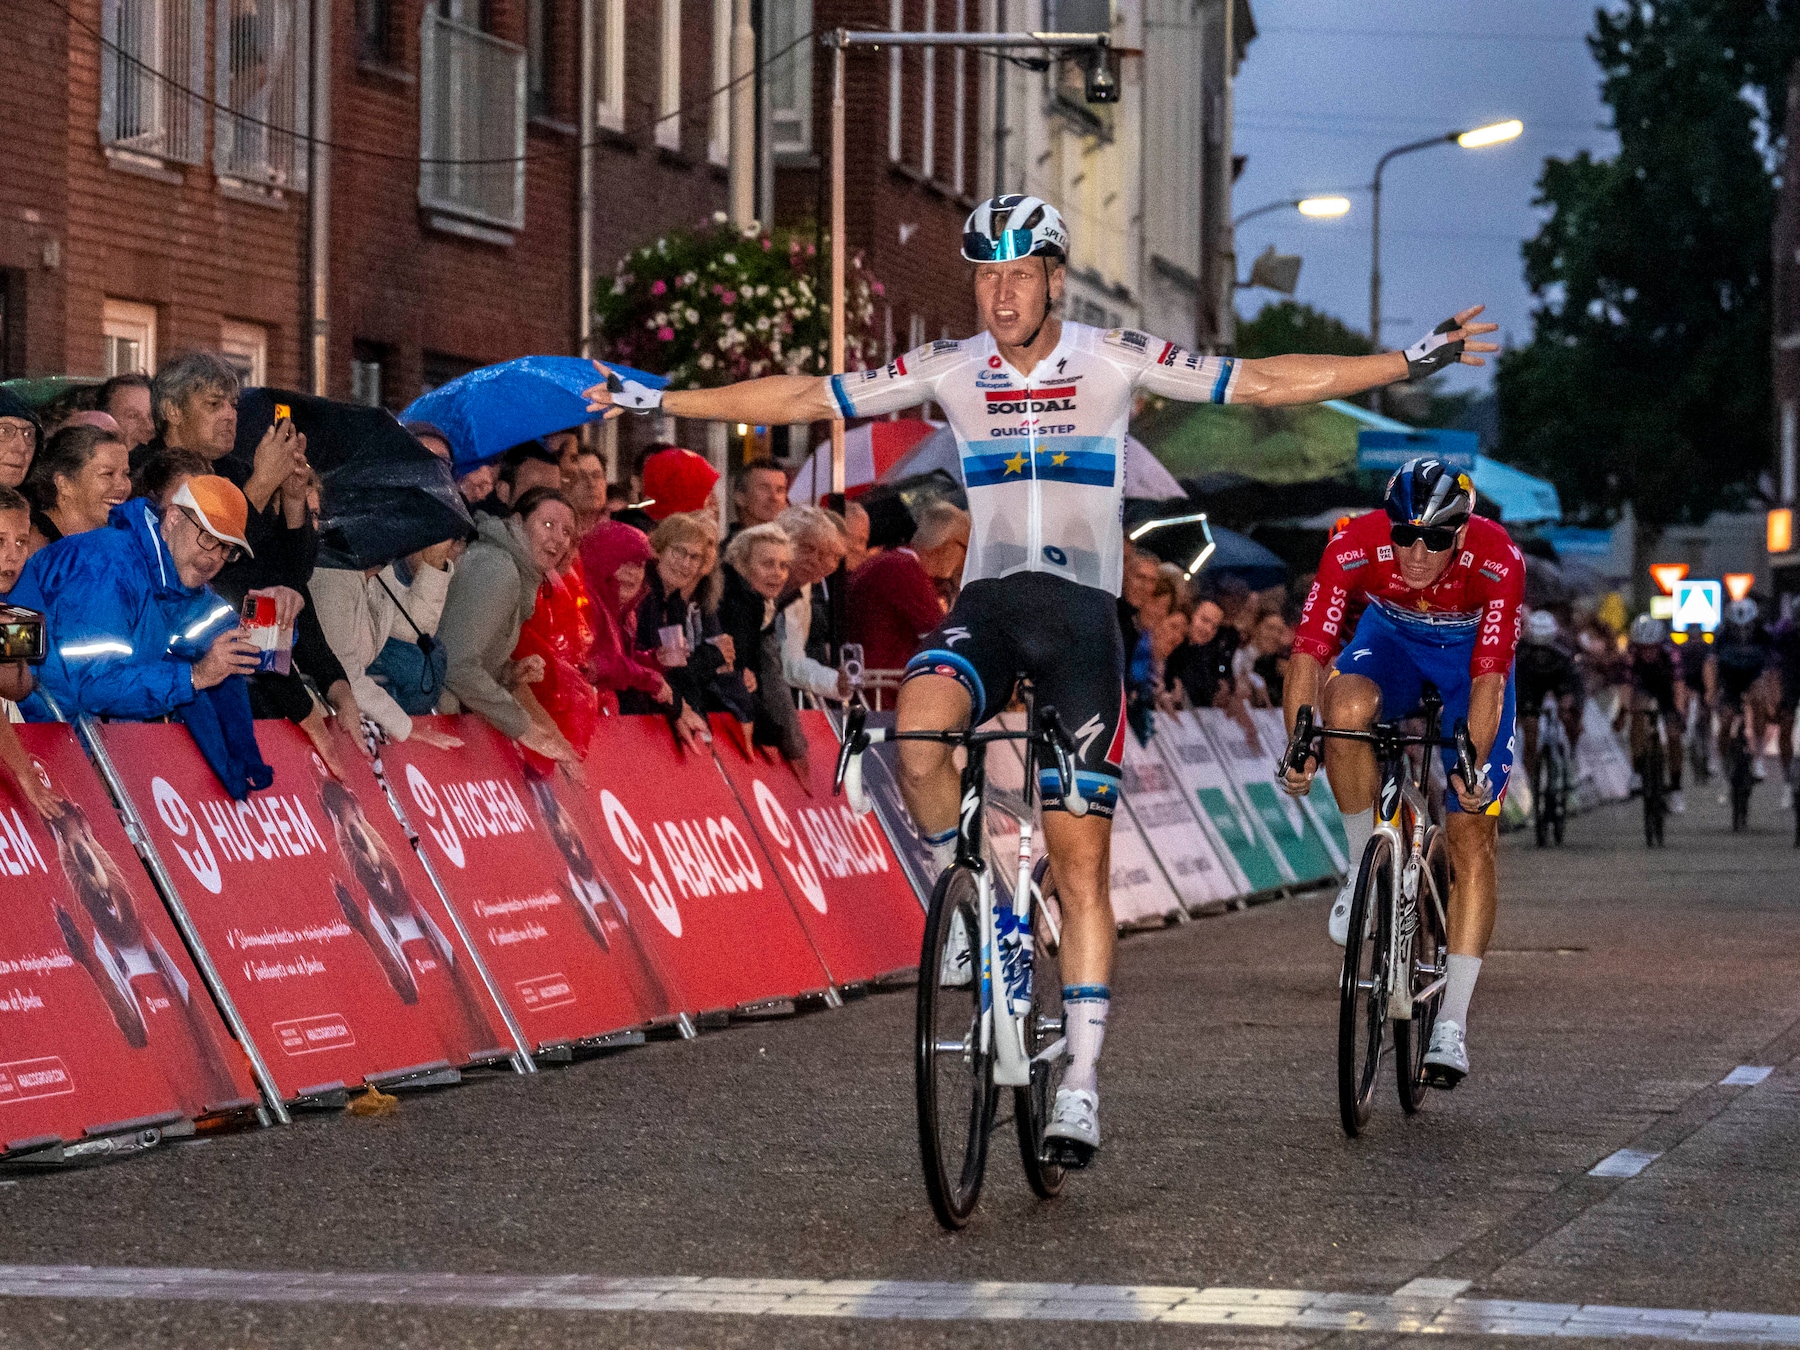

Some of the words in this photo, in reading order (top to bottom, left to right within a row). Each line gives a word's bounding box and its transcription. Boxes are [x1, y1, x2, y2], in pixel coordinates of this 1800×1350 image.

[975, 380, 1013, 389] Ekopak
[987, 399, 1076, 415] SOUDAL
[1336, 548, 1366, 564] BORA
[1322, 585, 1347, 636] BOSS
[1481, 599, 1504, 646] BOSS
[199, 794, 327, 862] HUCHEM
[441, 778, 535, 839] HUCHEM
[653, 815, 763, 900] ABALCO
[798, 805, 888, 878] ABALCO
